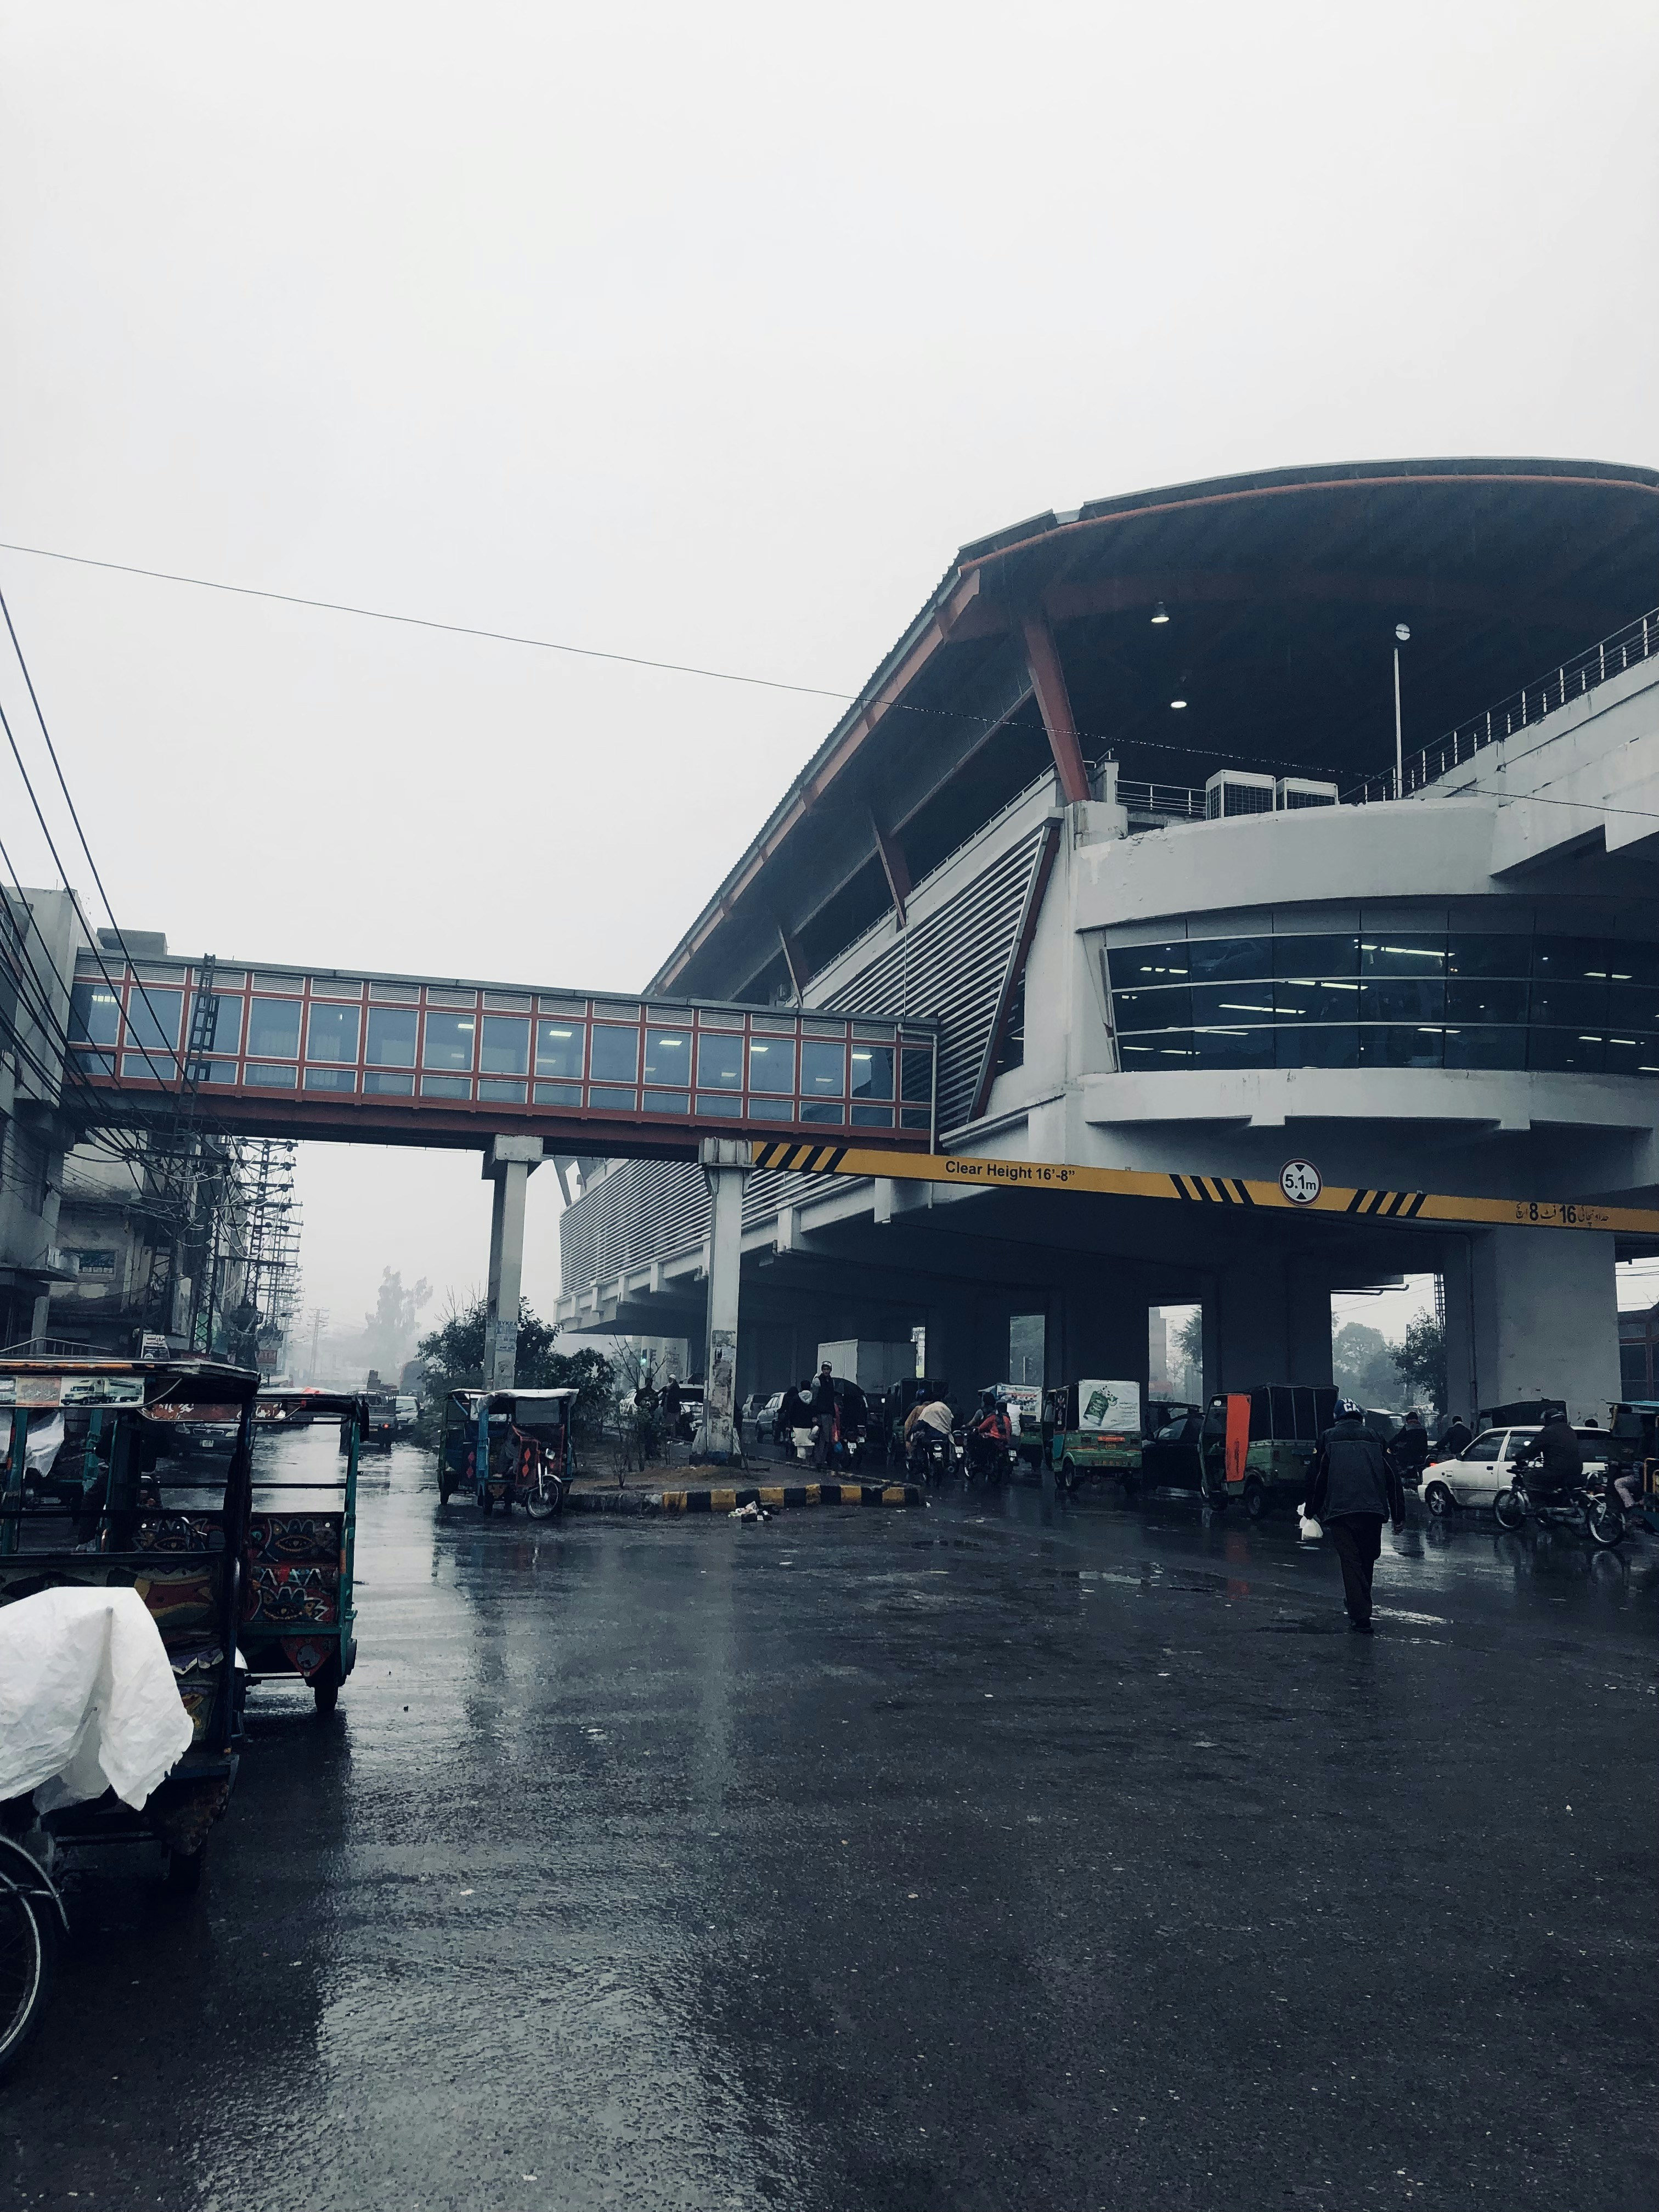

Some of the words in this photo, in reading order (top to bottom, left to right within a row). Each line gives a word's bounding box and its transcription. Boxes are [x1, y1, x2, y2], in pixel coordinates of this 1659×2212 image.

[945, 1160, 983, 1175] Clear
[987, 1164, 1032, 1181] Height
[1285, 1173, 1316, 1190] 5.1m
[1529, 1202, 1539, 1221] 8
[1559, 1205, 1577, 1224] 16
